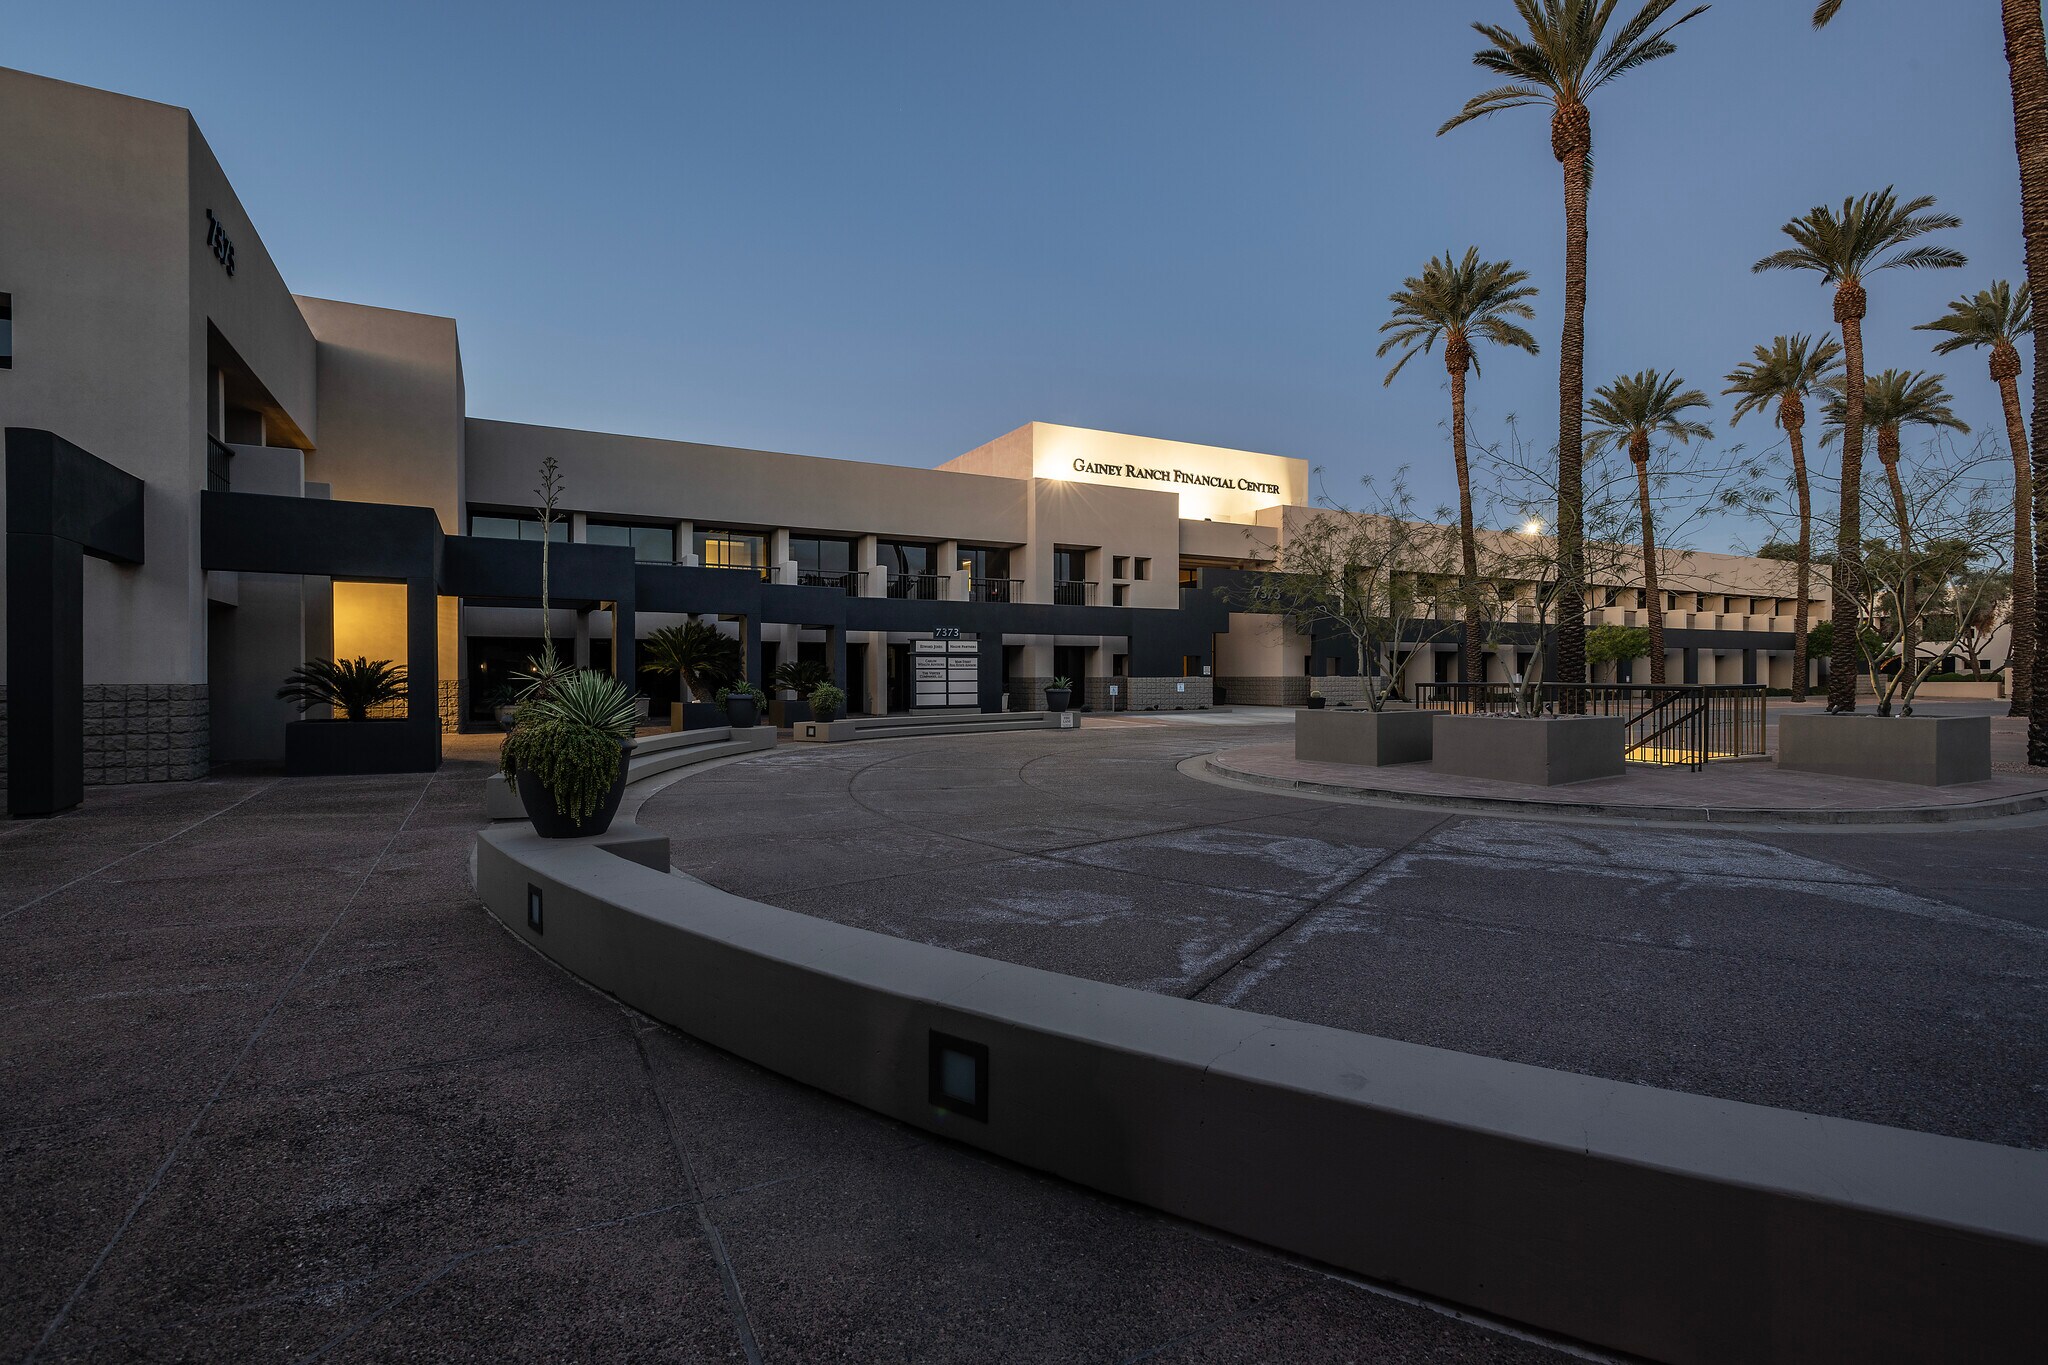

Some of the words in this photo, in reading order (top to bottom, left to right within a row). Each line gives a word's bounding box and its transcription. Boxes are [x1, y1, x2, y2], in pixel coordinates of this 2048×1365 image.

[1073, 458, 1123, 477] GAINEY
[1125, 464, 1171, 482] RANCH
[1173, 469, 1236, 489] FINANCIAL
[1237, 478, 1281, 495] CENTER
[935, 628, 959, 637] 7373
